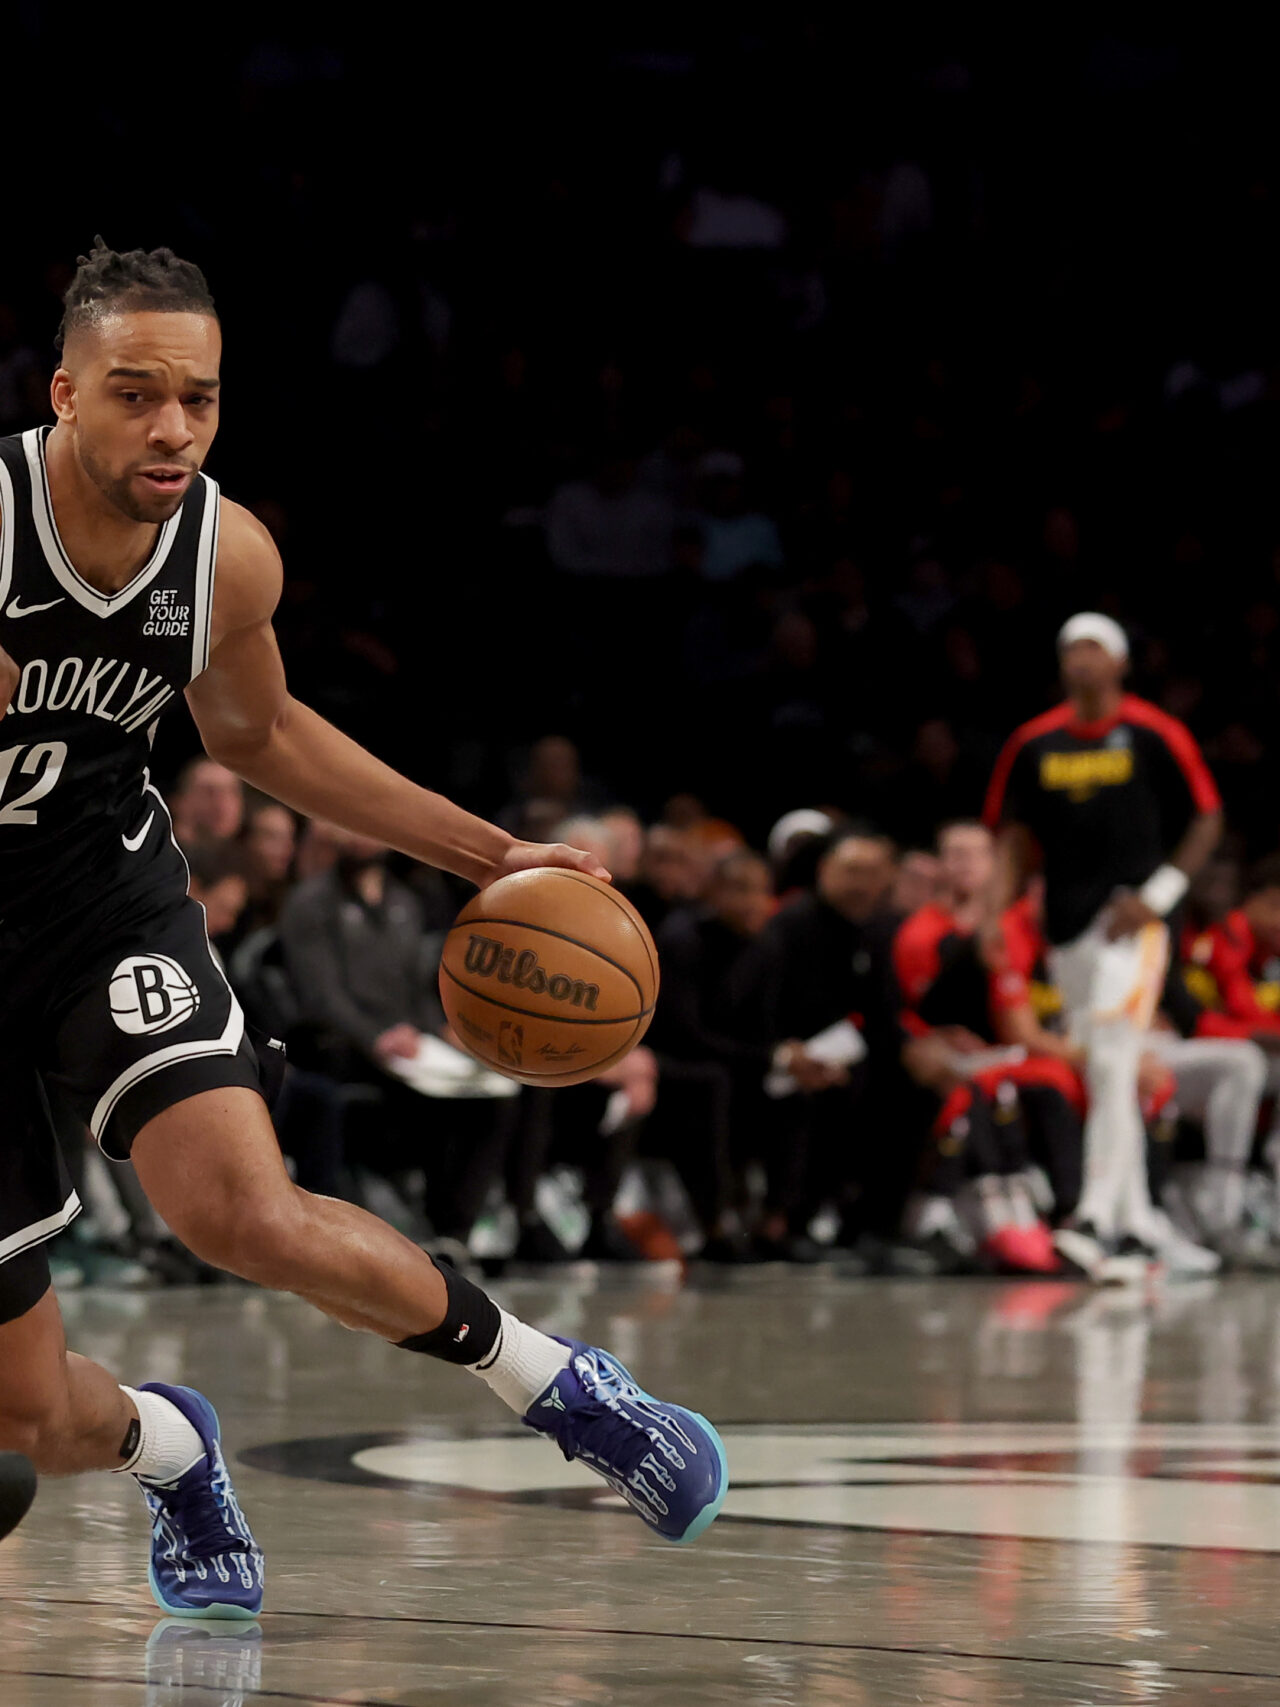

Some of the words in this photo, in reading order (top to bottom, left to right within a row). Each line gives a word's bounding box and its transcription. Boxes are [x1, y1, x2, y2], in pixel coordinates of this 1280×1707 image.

[150, 590, 178, 605] GET
[149, 605, 190, 620] YOUR
[142, 621, 190, 636] GUIDE
[464, 934, 600, 1012] Wilson
[133, 965, 172, 1024] B
